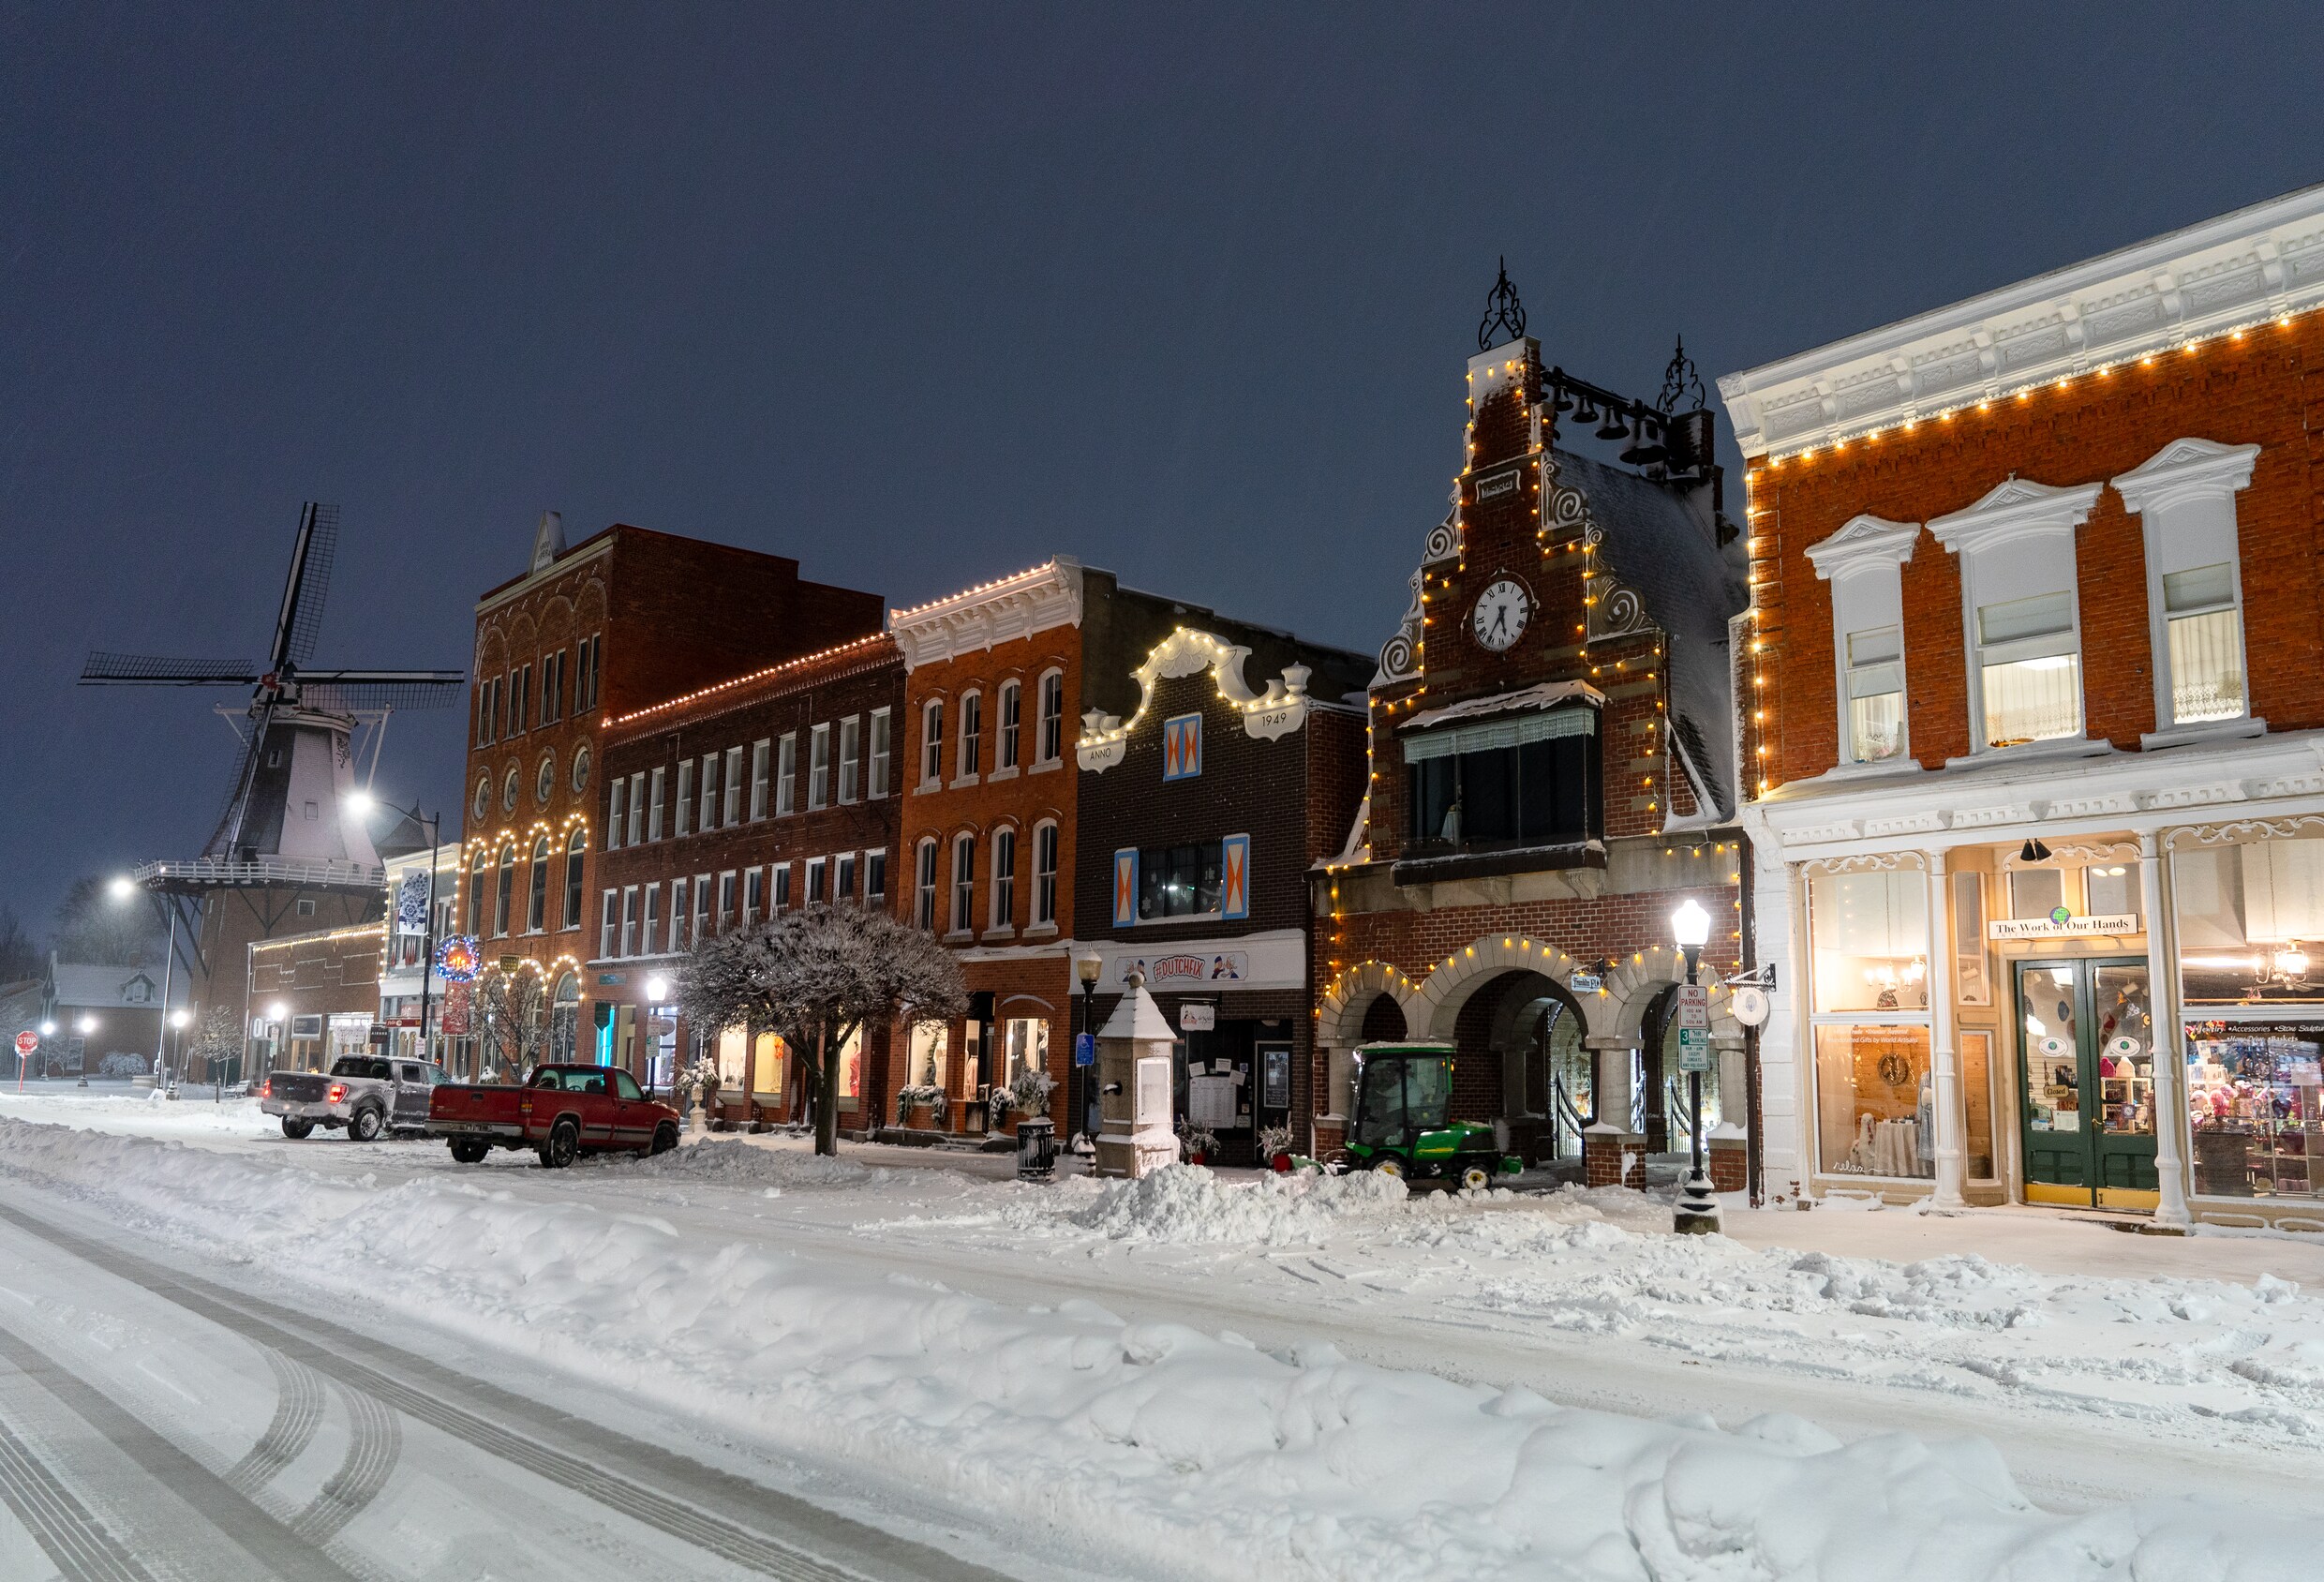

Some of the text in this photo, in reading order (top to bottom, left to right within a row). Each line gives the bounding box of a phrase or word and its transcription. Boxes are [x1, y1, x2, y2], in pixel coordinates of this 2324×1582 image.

[1262, 712, 1287, 727] 1949
[1090, 747, 1111, 761] ANNO
[1996, 918, 2129, 933] The Work of Our Hands
[1155, 957, 1204, 980] #DUTCHFIX
[1680, 998, 1706, 1007] PARKING
[19, 1037, 37, 1045] STOP
[1682, 1031, 1689, 1041] 3
[2047, 1087, 2066, 1096] Closed
[1833, 1159, 1867, 1172] relax
